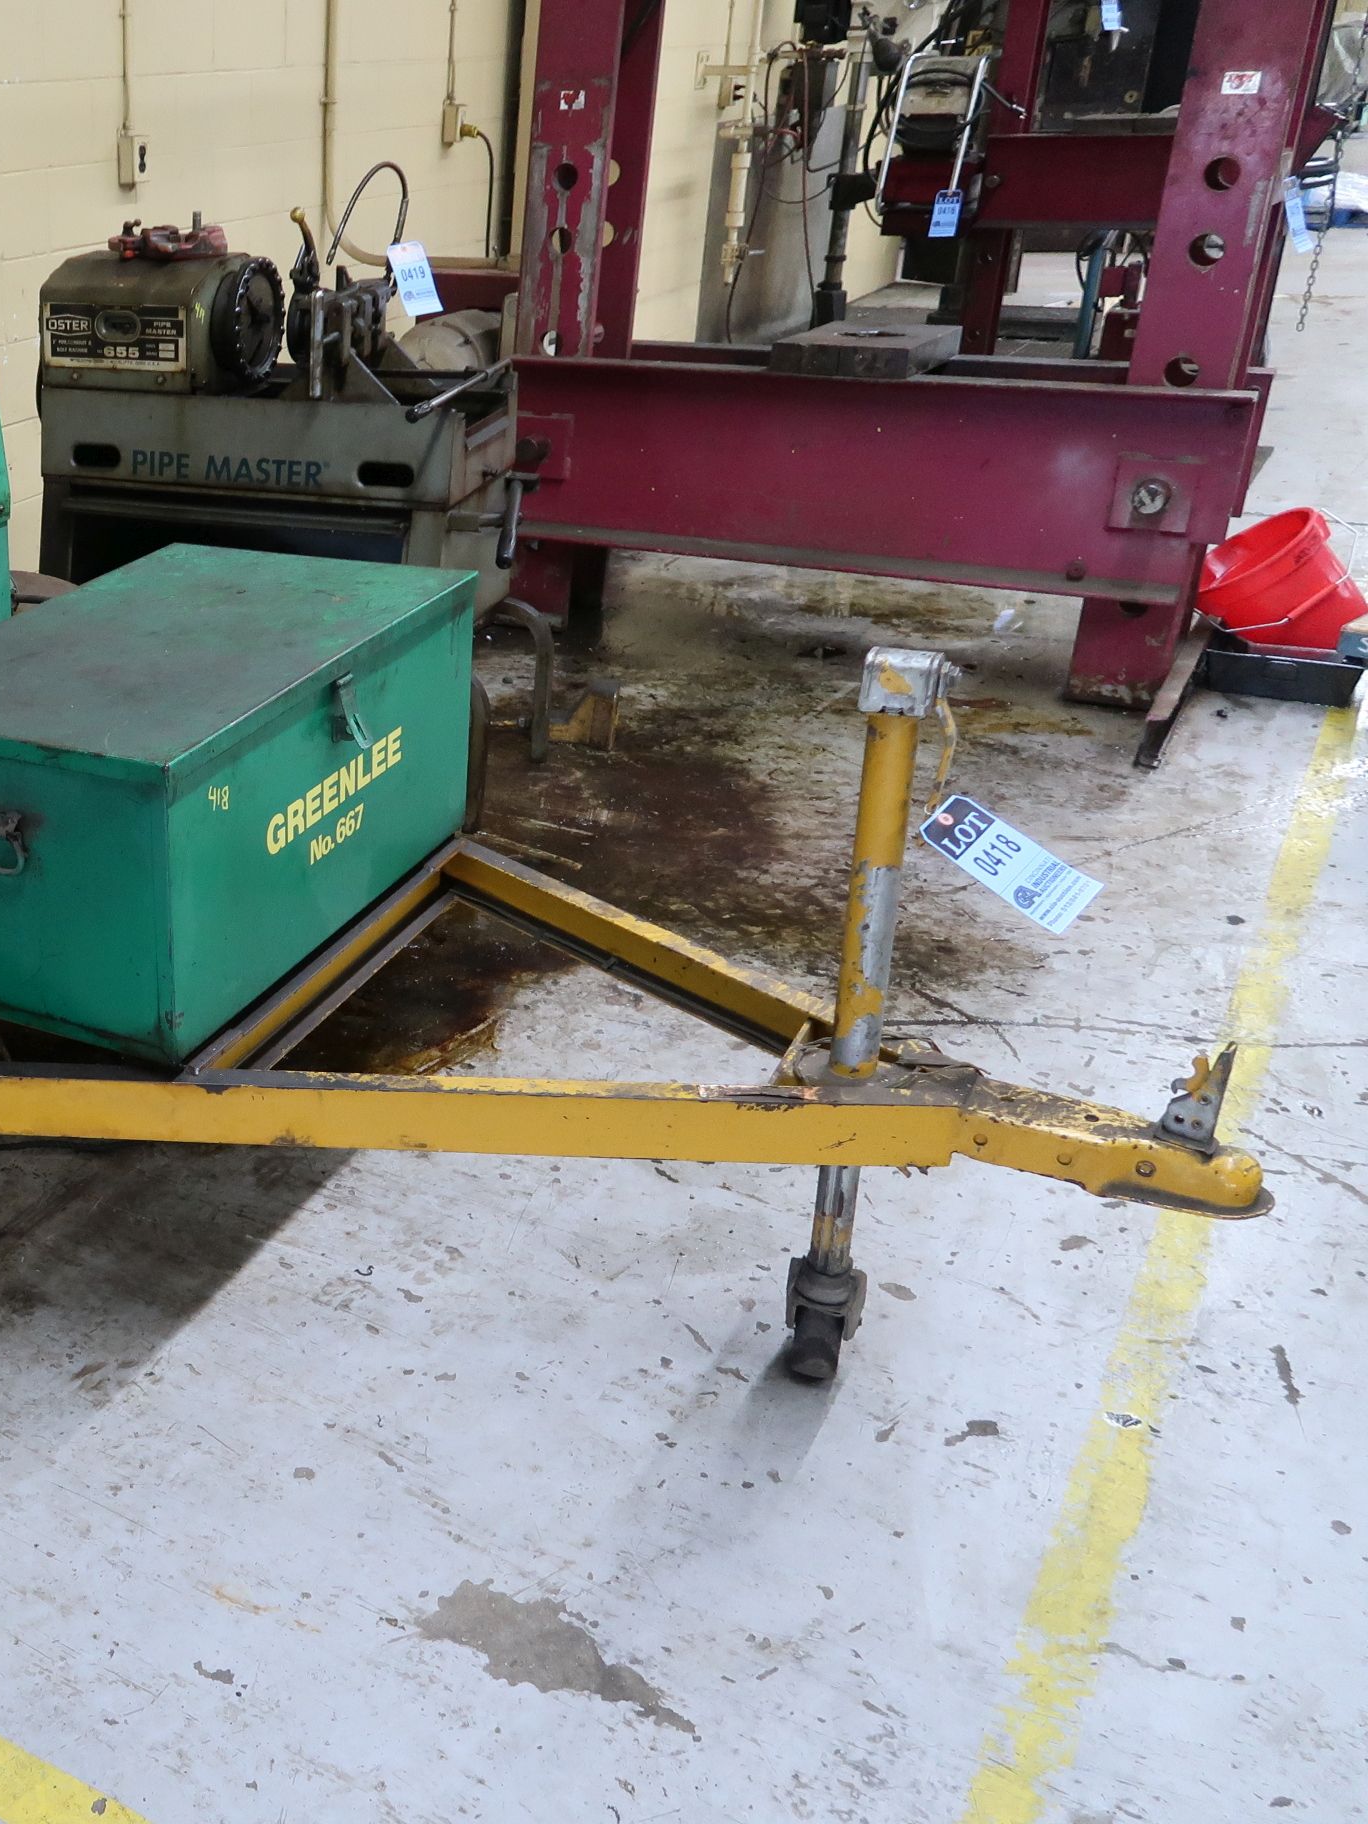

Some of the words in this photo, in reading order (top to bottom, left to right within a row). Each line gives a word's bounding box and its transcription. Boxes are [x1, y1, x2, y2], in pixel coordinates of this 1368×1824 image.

[400, 265, 426, 282] 0419
[48, 319, 89, 331] OSTER
[145, 328, 177, 336] MASTER
[103, 346, 140, 358] 655
[132, 448, 190, 480] PIPE
[205, 454, 324, 488] MASTER
[208, 784, 230, 811] 418
[266, 726, 402, 855] GREENLEE
[310, 834, 335, 865] No.
[335, 802, 364, 844] 667
[941, 811, 989, 855] LOT
[973, 834, 1022, 877] 0418
[1031, 862, 1061, 888] INDUSTRIAL
